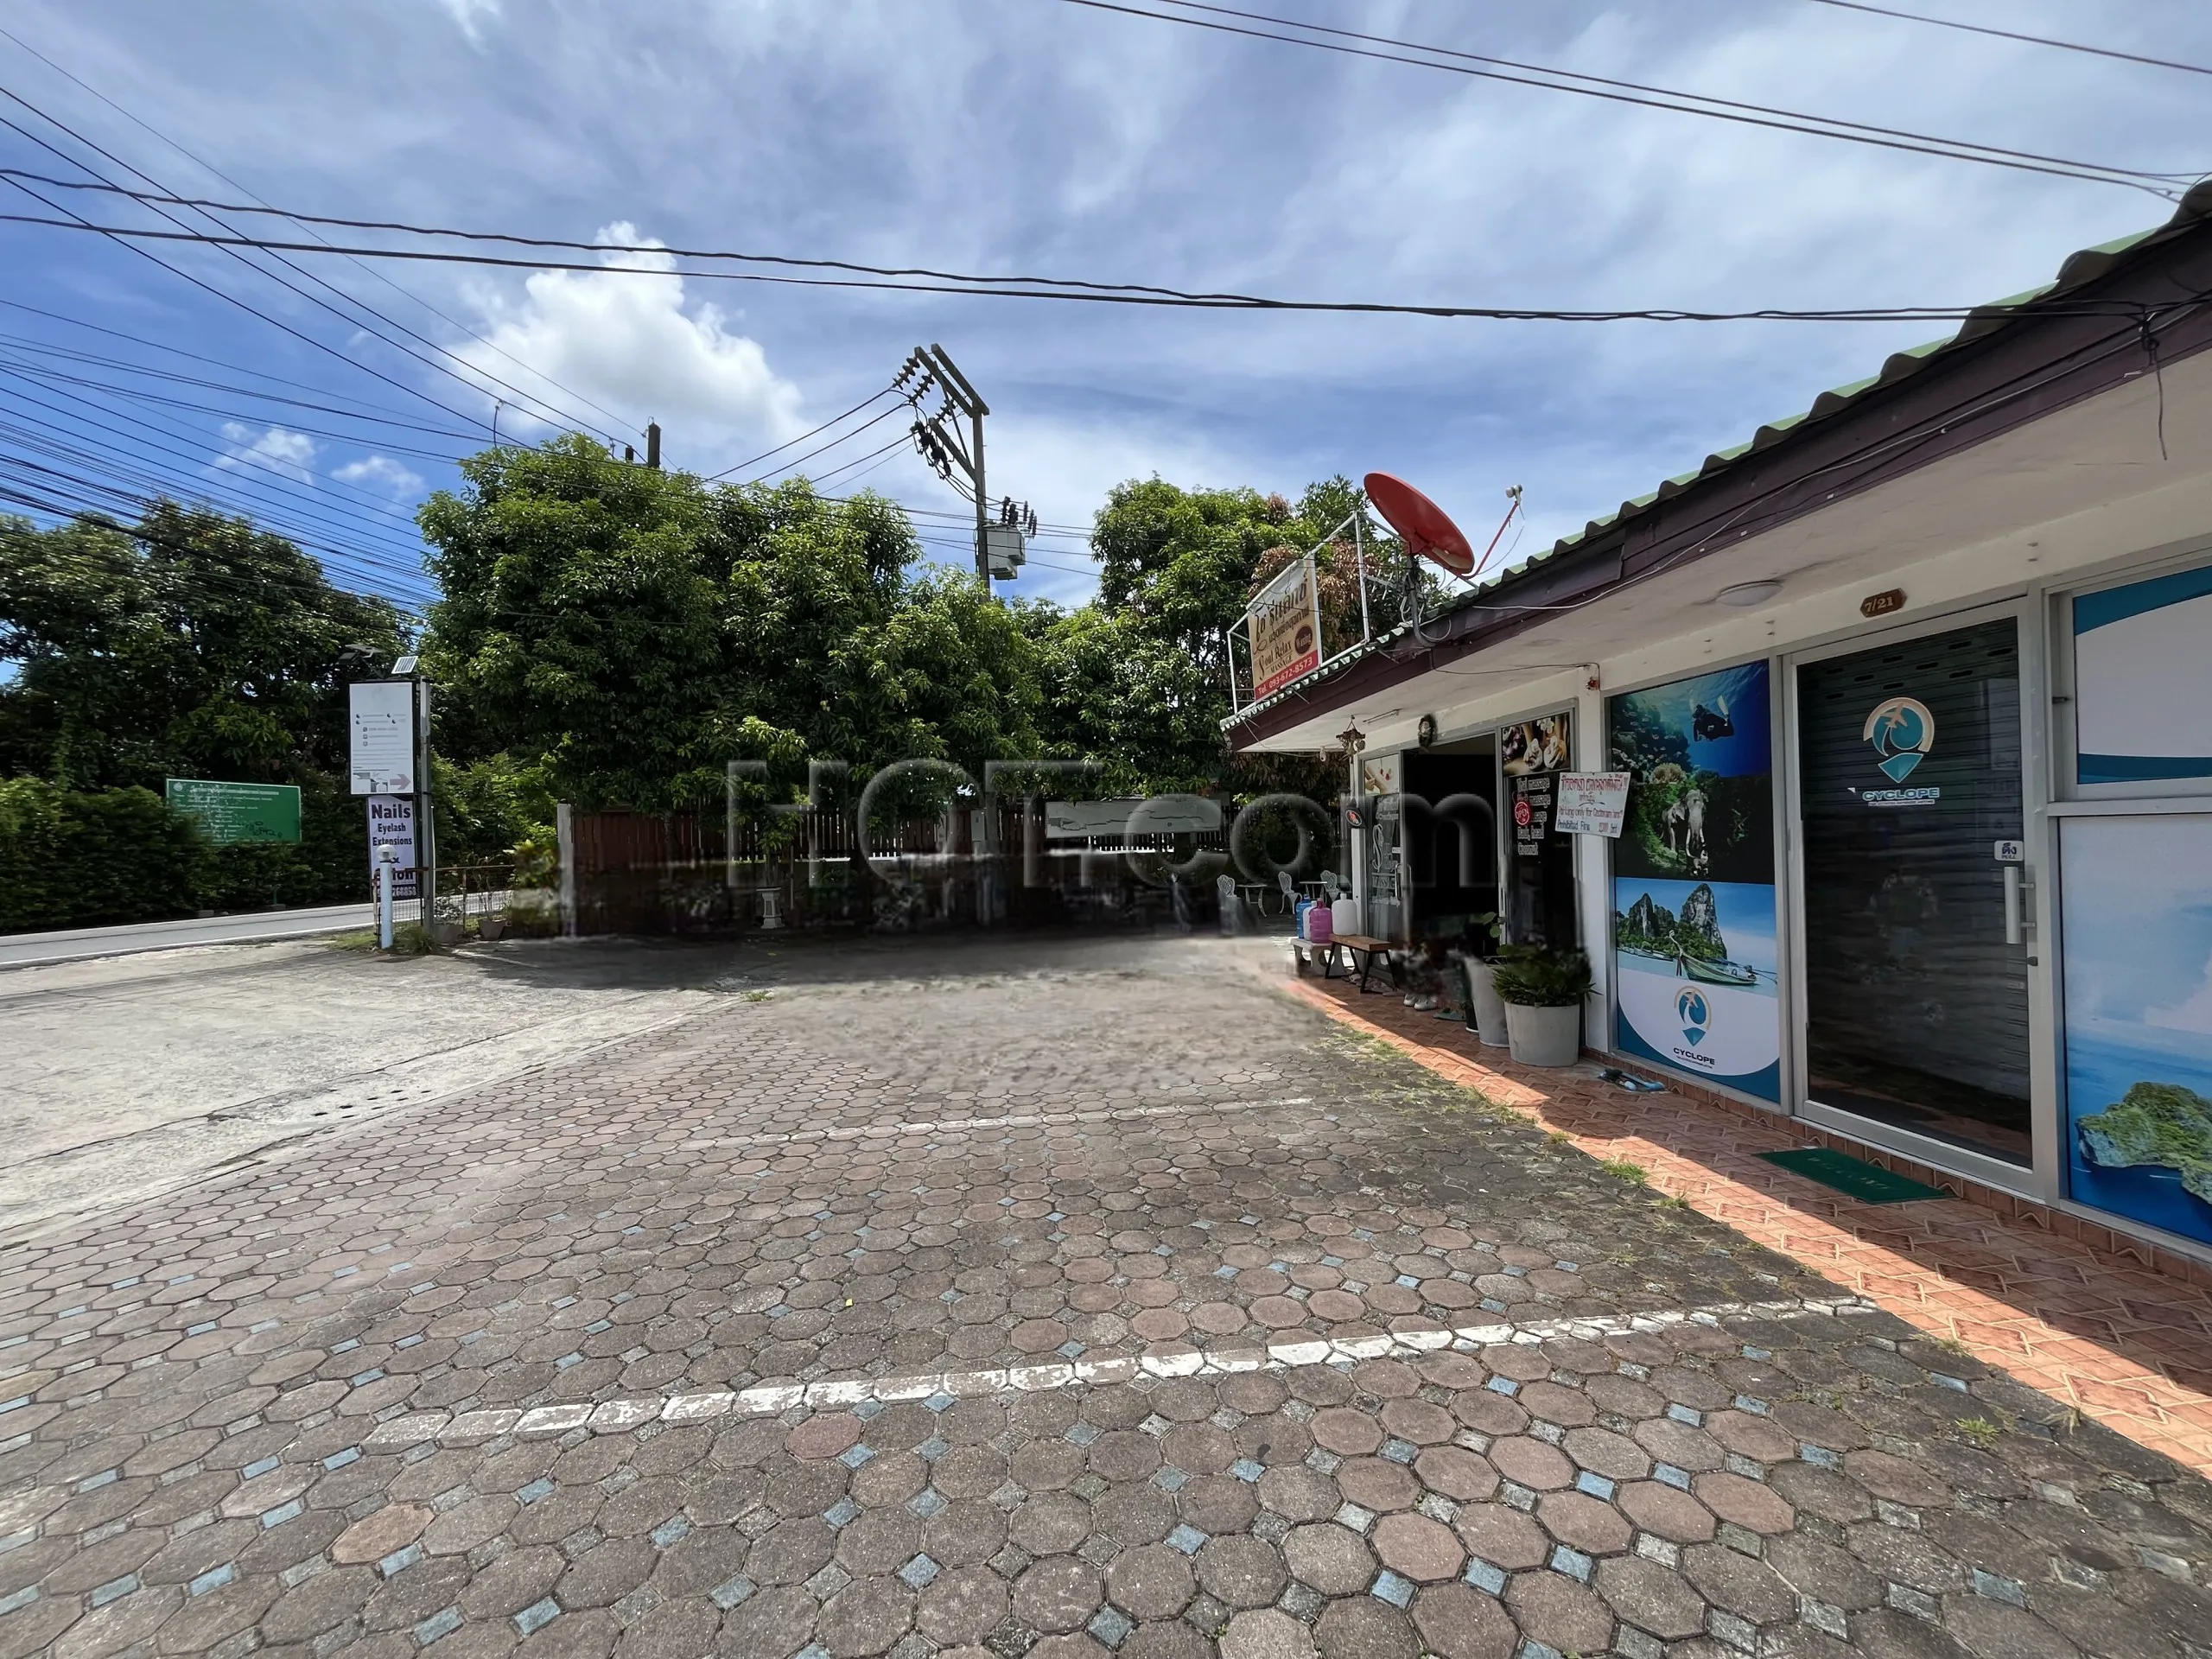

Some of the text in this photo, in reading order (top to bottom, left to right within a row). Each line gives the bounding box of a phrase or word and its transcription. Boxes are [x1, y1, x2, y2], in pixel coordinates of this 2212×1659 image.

[1864, 595, 1894, 613] 7/21
[1274, 640, 1293, 660] Relax
[1268, 656, 1313, 690] 093-672-8573
[1528, 778, 1550, 791] massage
[1529, 794, 1551, 808] massage
[1862, 787, 1940, 801] CYCLOPE
[372, 804, 411, 819] Nails
[378, 823, 406, 835] Eyelash
[372, 836, 412, 846] Extensions
[2002, 842, 2017, 855] ดึง
[1673, 1047, 1715, 1065] CYCLOPE
